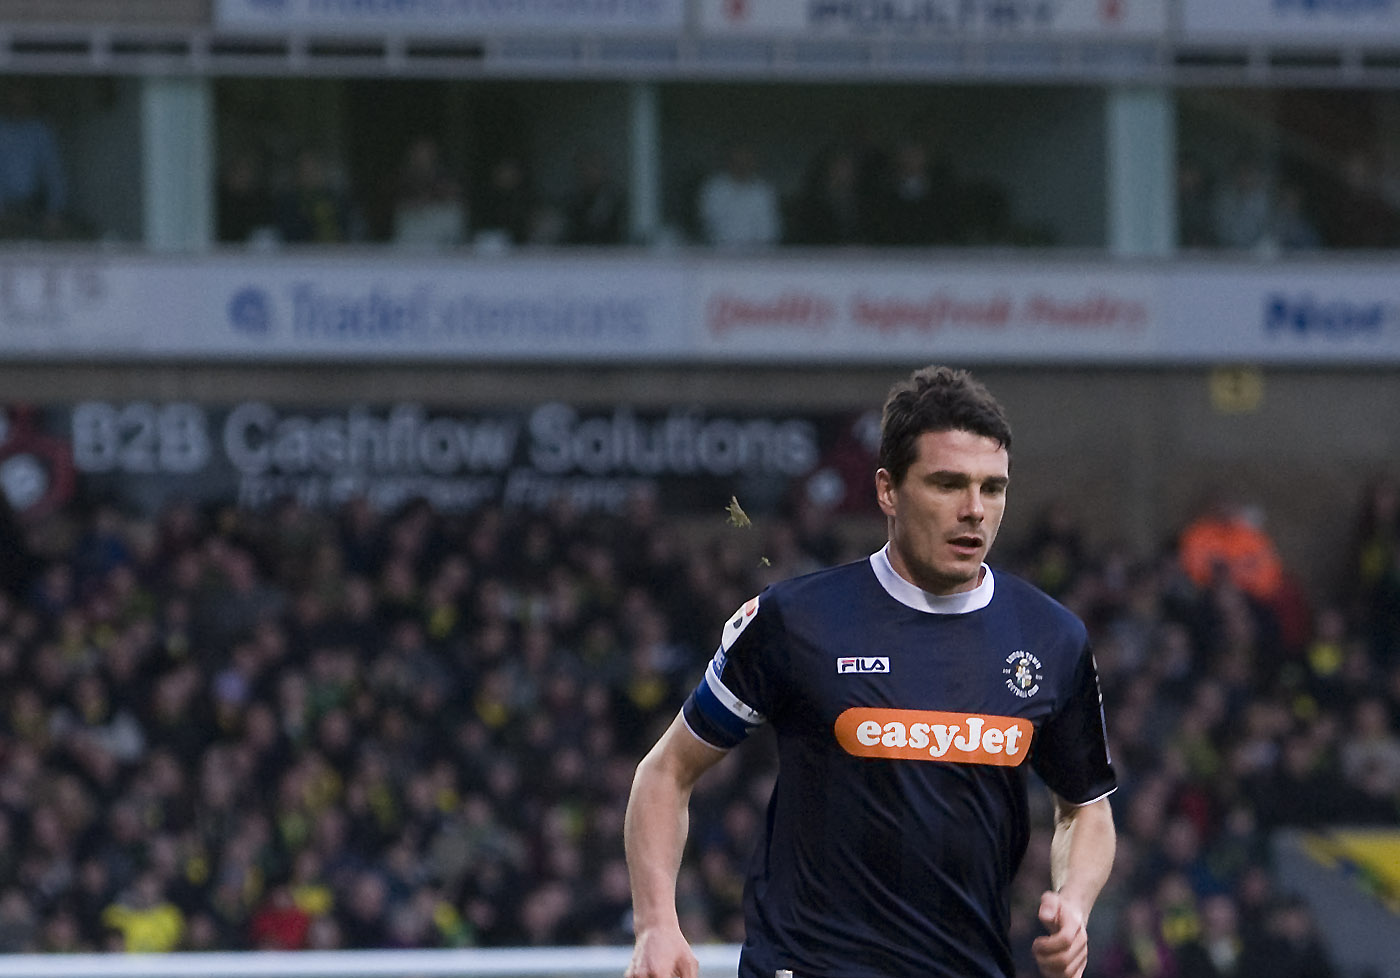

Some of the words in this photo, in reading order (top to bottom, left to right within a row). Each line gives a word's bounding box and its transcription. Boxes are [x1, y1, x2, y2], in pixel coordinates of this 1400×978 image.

[72, 402, 209, 472] B2B
[223, 400, 514, 474] Cashflow
[528, 400, 818, 474] Solutions
[841, 659, 886, 672] FILA
[856, 717, 1023, 758] easyJet
